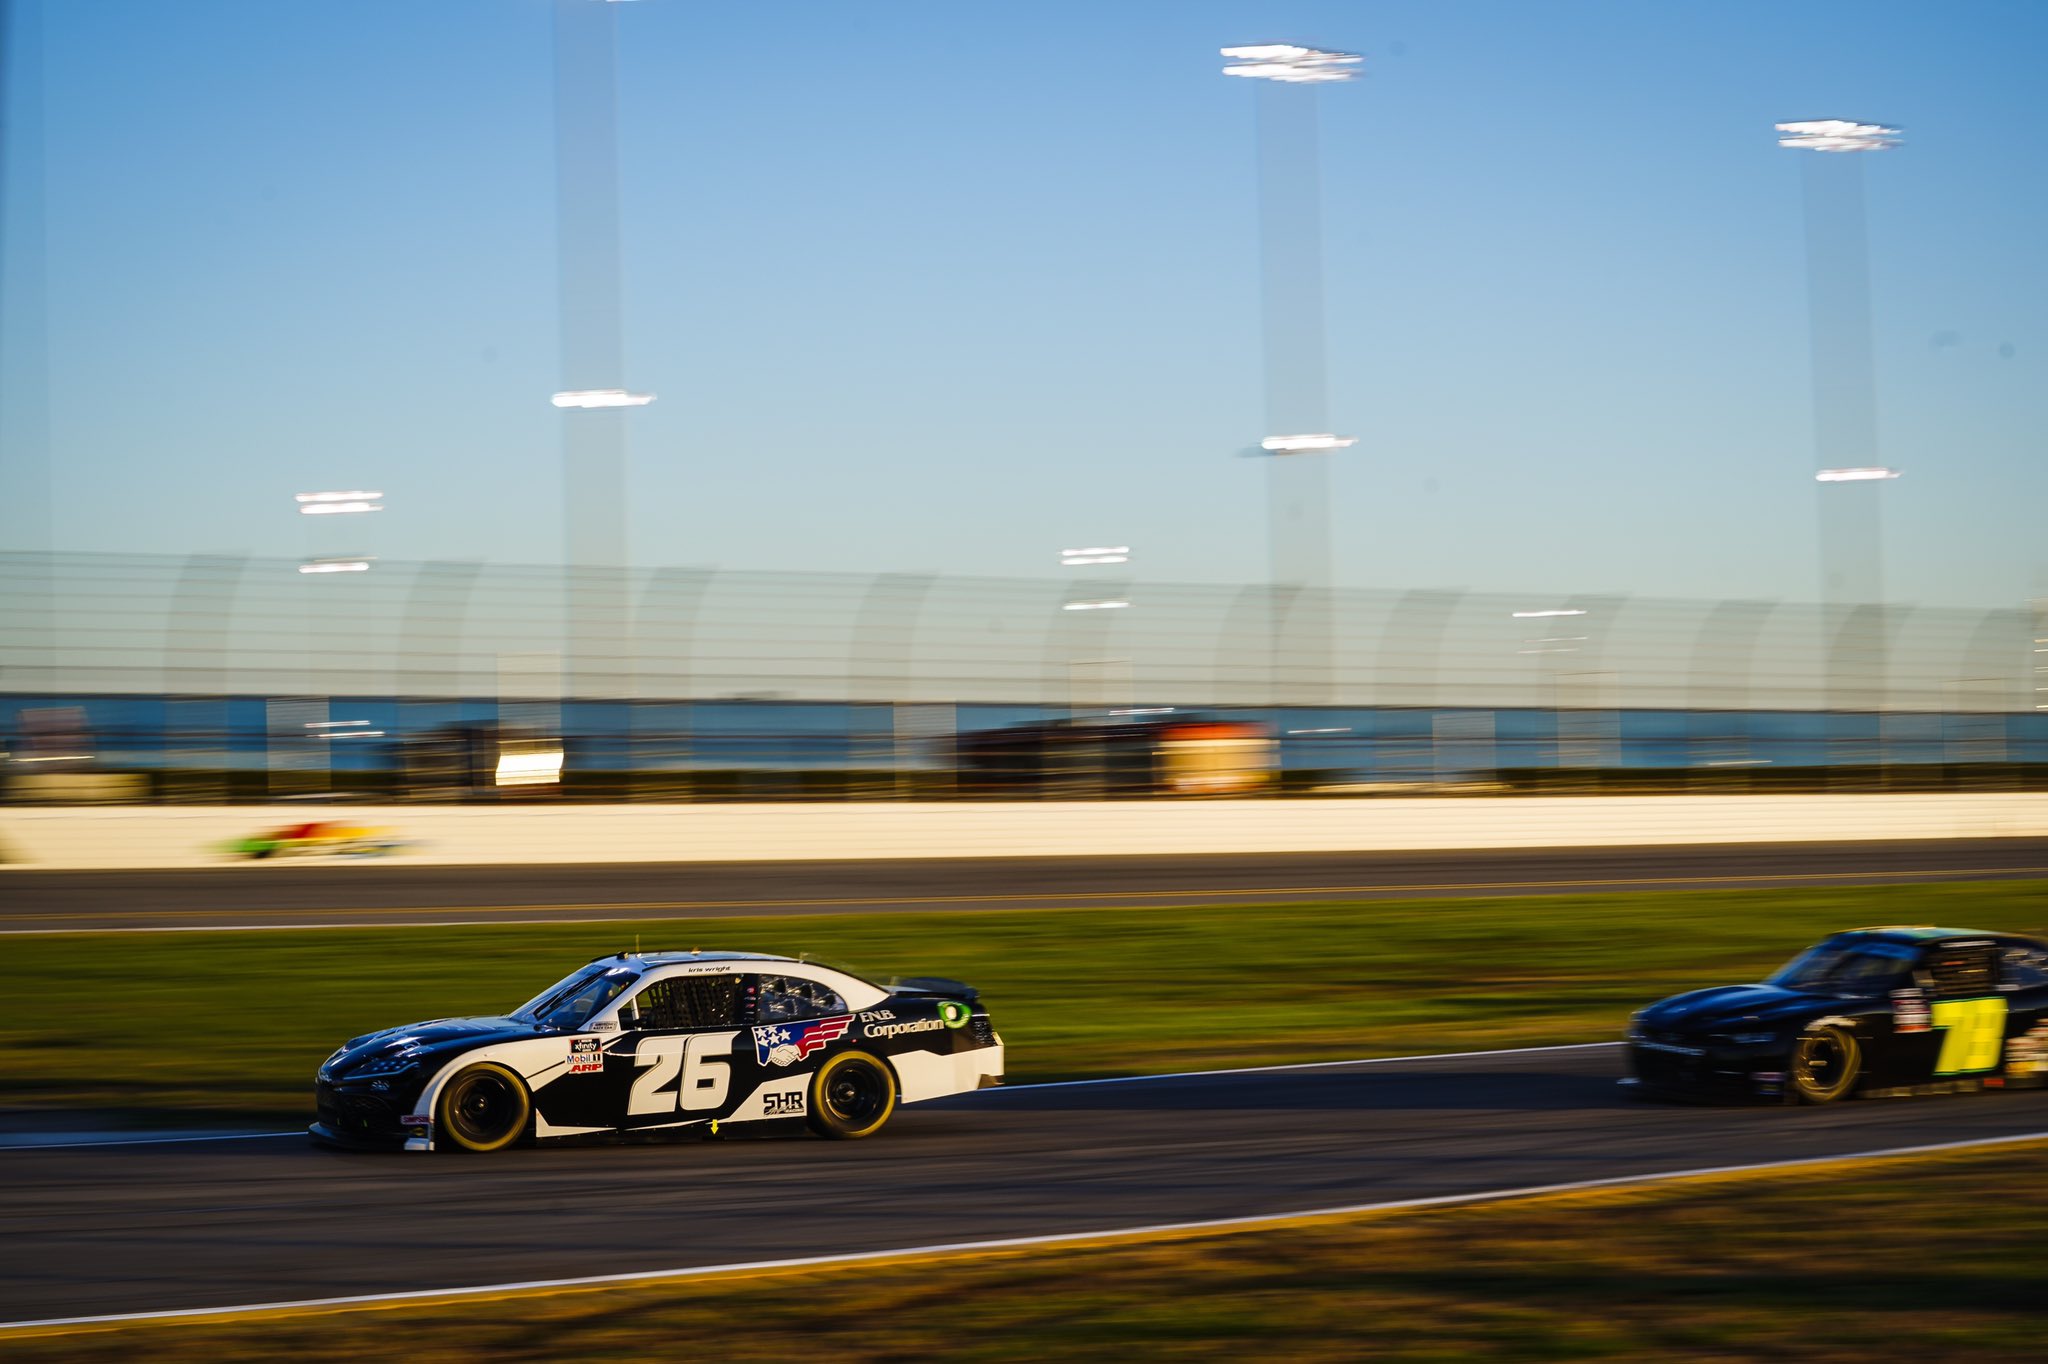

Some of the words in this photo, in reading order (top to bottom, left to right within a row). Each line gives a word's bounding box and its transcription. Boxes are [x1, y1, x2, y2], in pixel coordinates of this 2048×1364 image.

[863, 1018, 945, 1039] Corporation
[574, 1042, 597, 1051] xfinity
[567, 1054, 591, 1064] Mobil
[570, 1063, 602, 1072] ARP
[627, 1030, 742, 1116] 26
[763, 1091, 804, 1115] SHR
